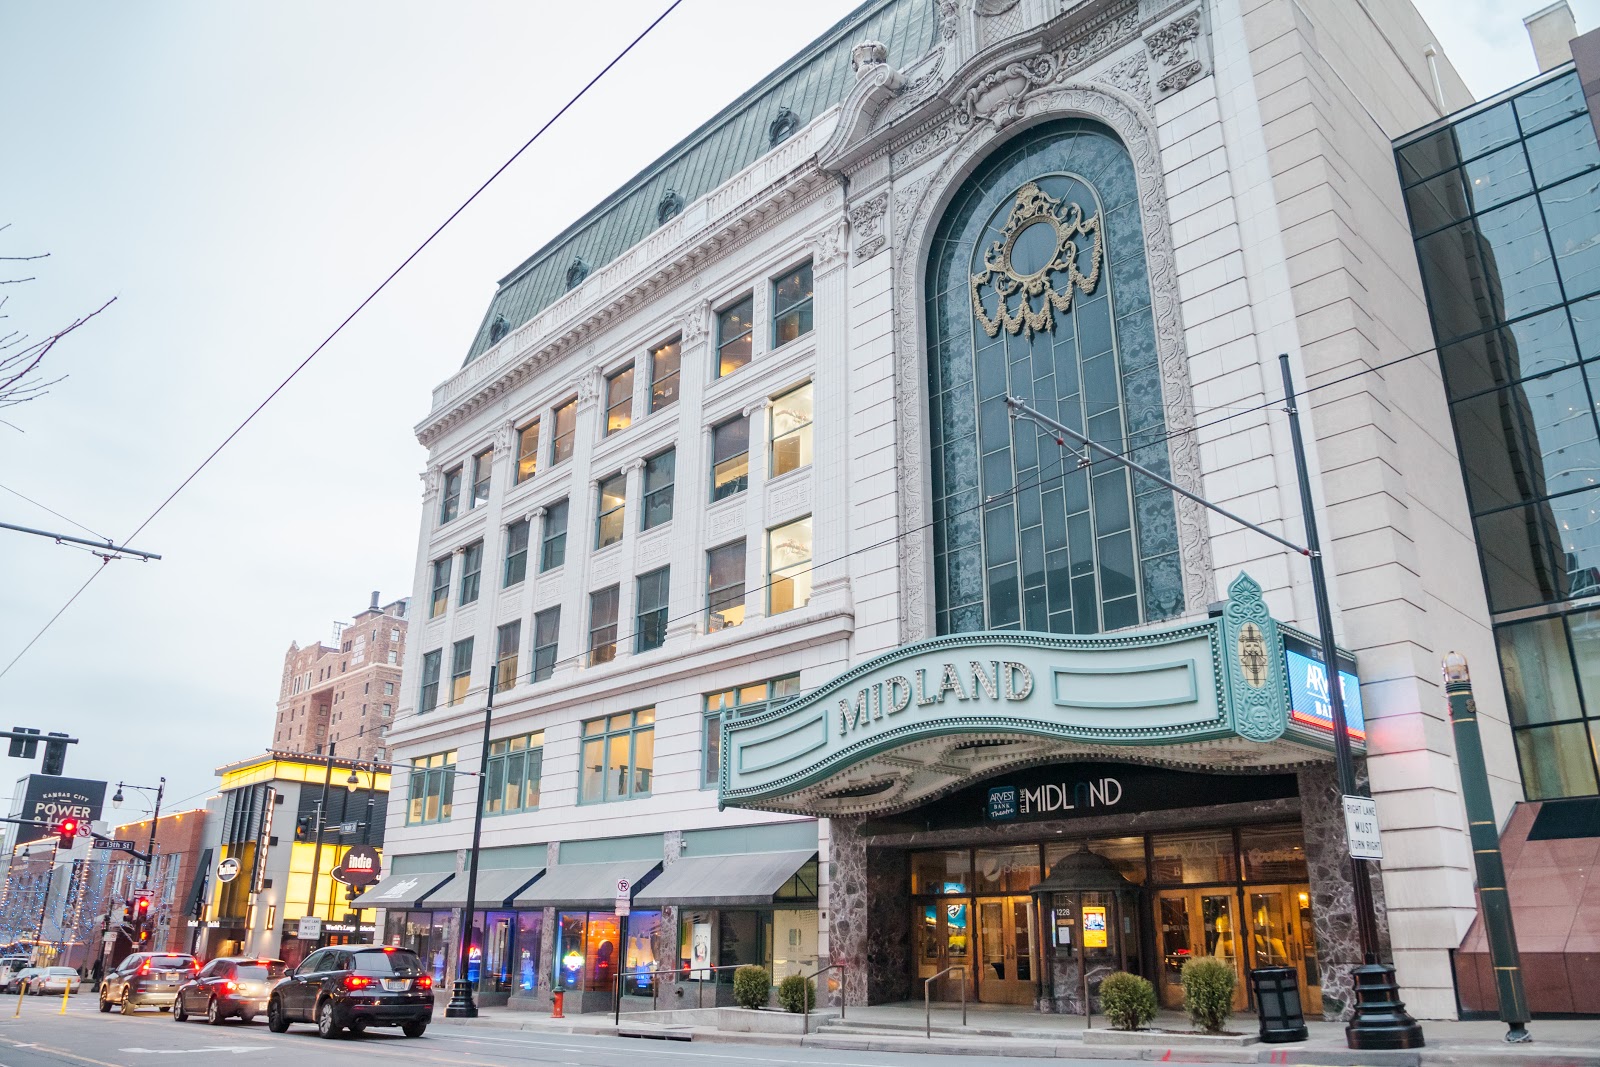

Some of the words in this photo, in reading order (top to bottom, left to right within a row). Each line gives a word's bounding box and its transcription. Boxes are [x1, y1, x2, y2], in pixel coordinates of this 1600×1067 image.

[838, 660, 1034, 736] MIDLAND
[73, 793, 89, 802] CITY
[990, 790, 1015, 803] ARVEST
[35, 803, 91, 818] POWER
[991, 808, 1015, 818] Theatre
[1020, 804, 1026, 814] AT
[1347, 804, 1362, 814] RIGHT
[1363, 805, 1376, 817] LANE
[1355, 821, 1373, 834] MUST
[1351, 839, 1365, 849] TURN
[1366, 840, 1380, 850] RIGHT
[348, 854, 372, 869] indie
[1056, 908, 1071, 916] 1228
